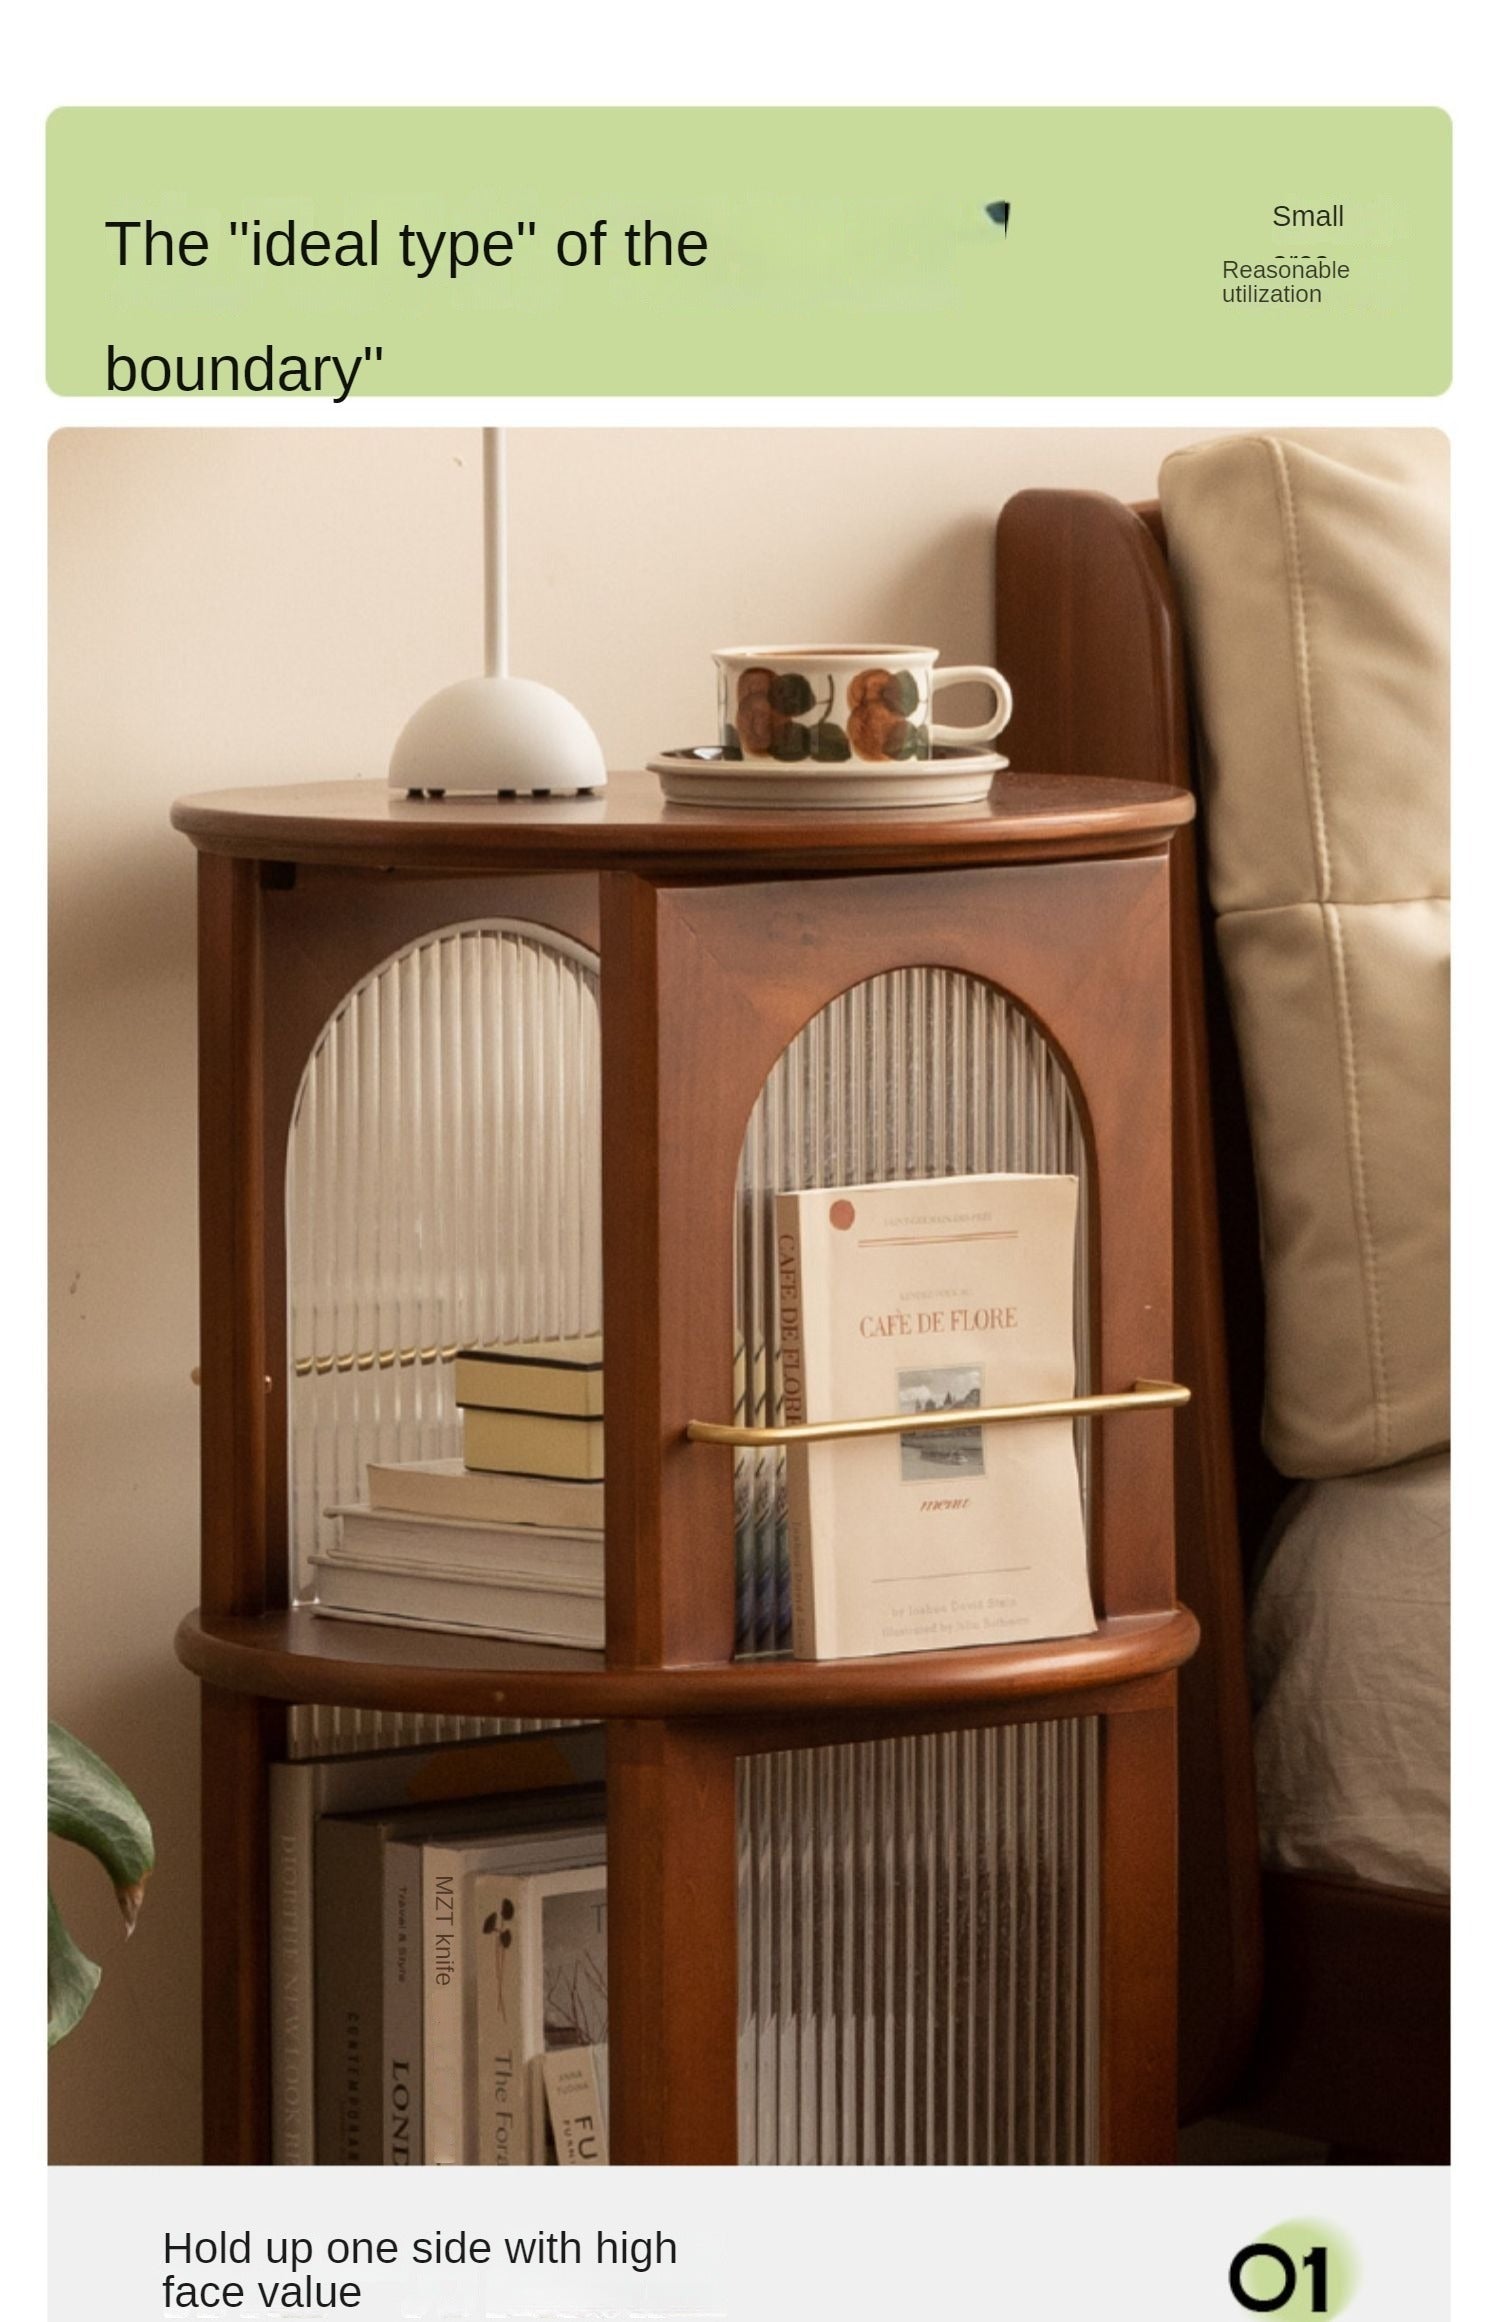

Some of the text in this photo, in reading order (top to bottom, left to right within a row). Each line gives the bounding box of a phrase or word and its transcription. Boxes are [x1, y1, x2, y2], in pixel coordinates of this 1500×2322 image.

[781, 1308, 799, 1342] DE
[918, 1311, 945, 1334] DE
[951, 1306, 1019, 1332] FLORE
[494, 2050, 513, 2103] The
